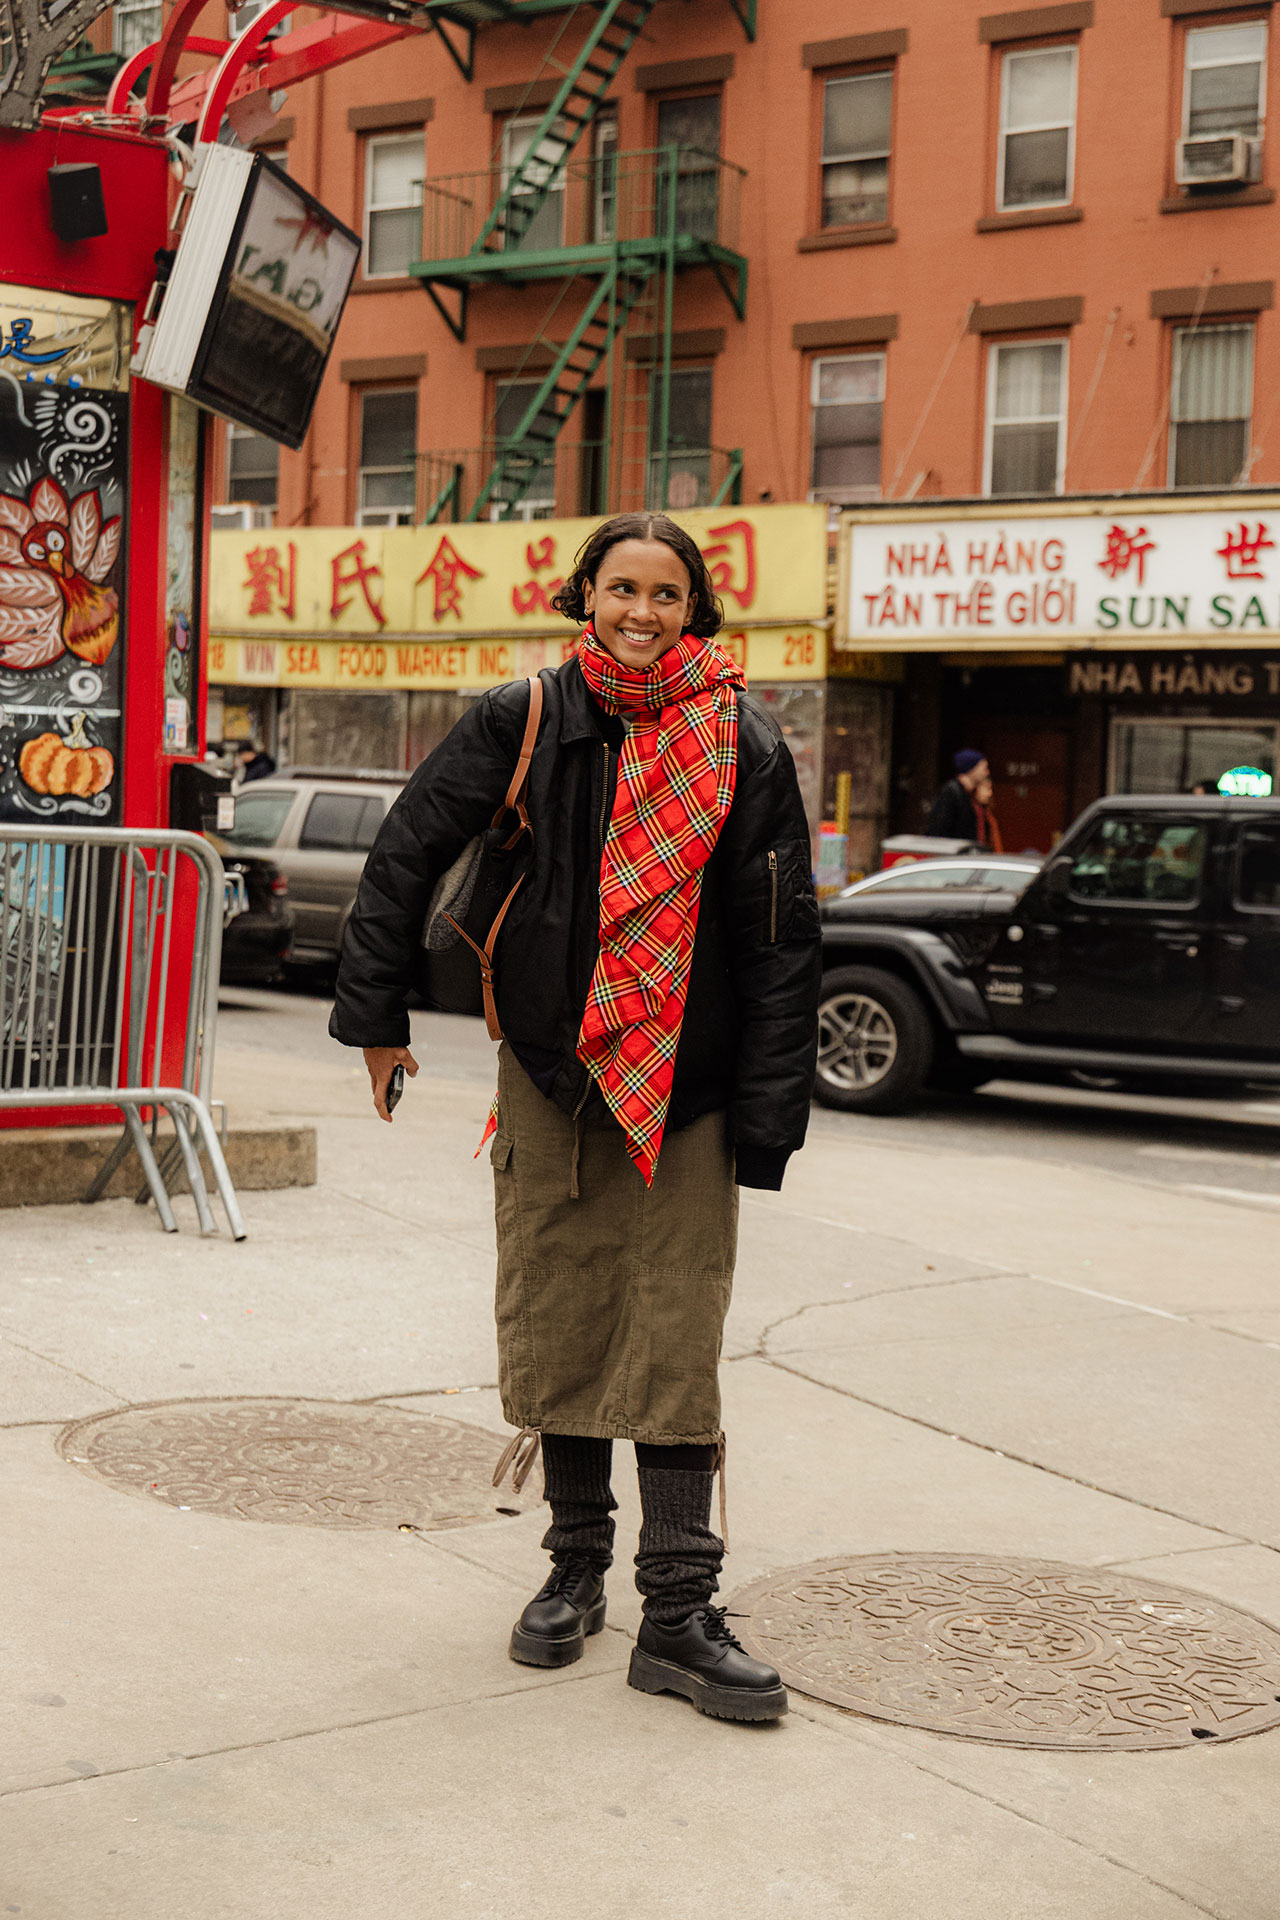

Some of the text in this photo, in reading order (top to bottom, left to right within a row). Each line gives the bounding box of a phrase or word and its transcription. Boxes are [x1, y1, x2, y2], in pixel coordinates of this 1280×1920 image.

[243, 520, 756, 627] 劉氏食品司
[1098, 522, 1275, 587] 新世
[863, 584, 923, 627] TÂN
[1096, 595, 1280, 629] SUN SA
[286, 645, 320, 674] SEA
[339, 646, 386, 677] FOOD
[398, 646, 468, 677] MARKET
[478, 646, 514, 677] INC.
[784, 633, 815, 666] 218
